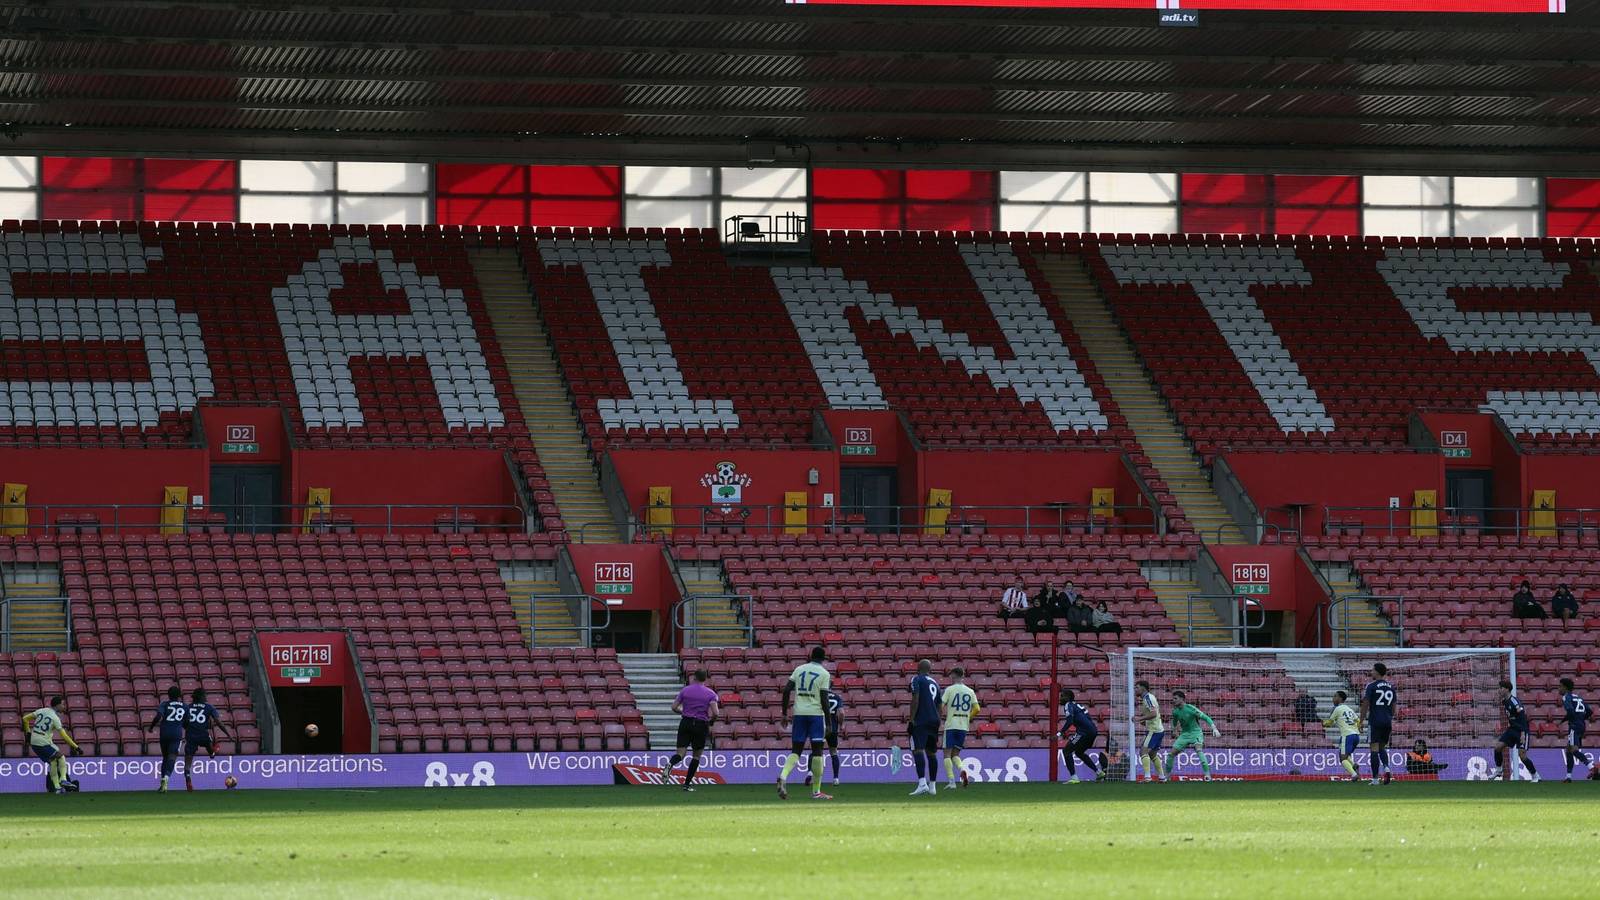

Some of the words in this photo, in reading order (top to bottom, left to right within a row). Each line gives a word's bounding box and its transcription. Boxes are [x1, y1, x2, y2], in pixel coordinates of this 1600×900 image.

[1161, 13, 1196, 22] adi.tv
[232, 428, 250, 439] D2
[850, 430, 867, 442] D3
[1445, 433, 1463, 445] D4
[597, 567, 612, 578] 17
[615, 567, 630, 578] 18
[1235, 567, 1250, 579] 18
[1252, 567, 1267, 579] 19
[274, 649, 290, 661] 16
[293, 649, 309, 661] 17
[312, 649, 328, 661] 18
[797, 671, 820, 691] 17
[928, 683, 938, 702] 9
[1375, 689, 1394, 706] 29
[951, 693, 972, 712] 48
[33, 713, 52, 732] 23
[166, 706, 186, 722] 28
[189, 708, 207, 724] 56
[526, 752, 561, 770] We
[732, 750, 770, 768] and
[1250, 748, 1287, 767] and
[113, 760, 185, 779] peope
[192, 755, 233, 774] and
[238, 755, 387, 778] organizations.
[424, 760, 496, 787] 8x8
[959, 756, 1029, 782] 8x8
